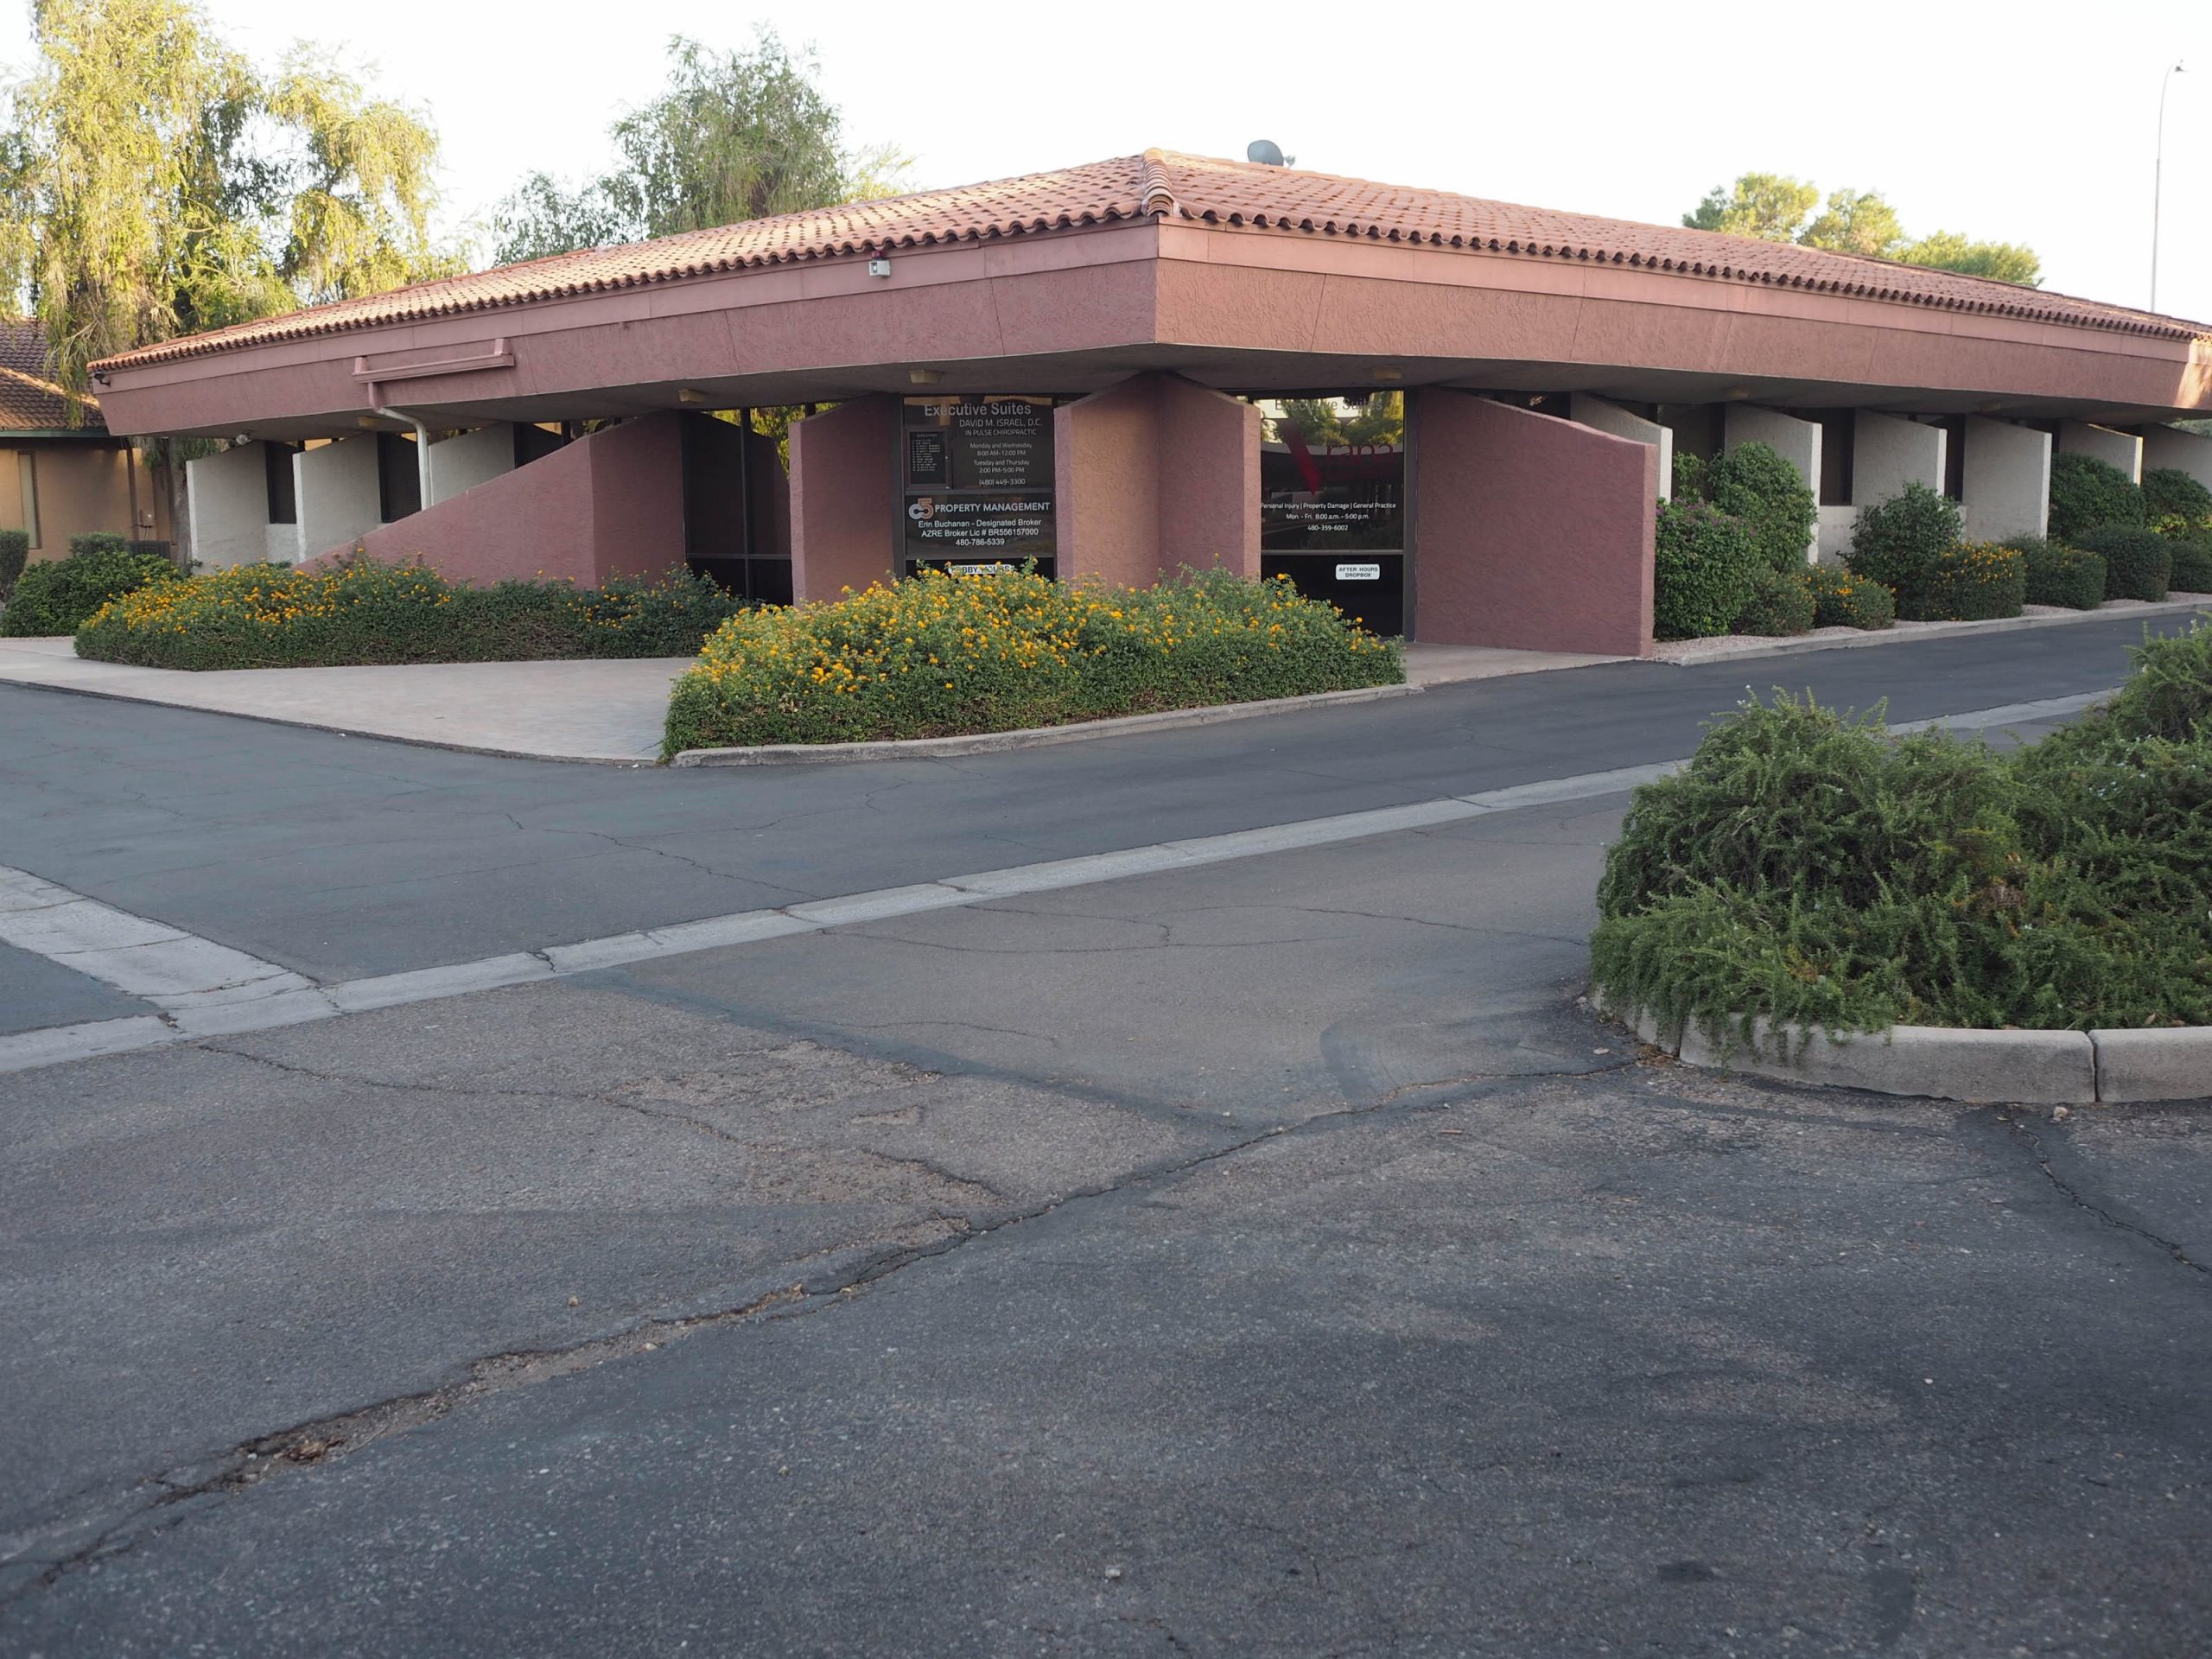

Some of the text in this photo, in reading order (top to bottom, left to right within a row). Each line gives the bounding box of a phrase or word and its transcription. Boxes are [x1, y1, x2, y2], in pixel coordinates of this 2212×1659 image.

[924, 402, 1031, 416] Executive Suites
[959, 419, 983, 427] DAVID
[985, 419, 994, 427] M.
[997, 419, 1026, 428] ISRAEL,
[935, 503, 981, 513] PROPERTY
[983, 502, 1051, 512] MANAGEMENT
[976, 519, 1017, 528] Designated
[988, 528, 1039, 536] BR556157000
[955, 538, 1004, 547] 480-786-5339
